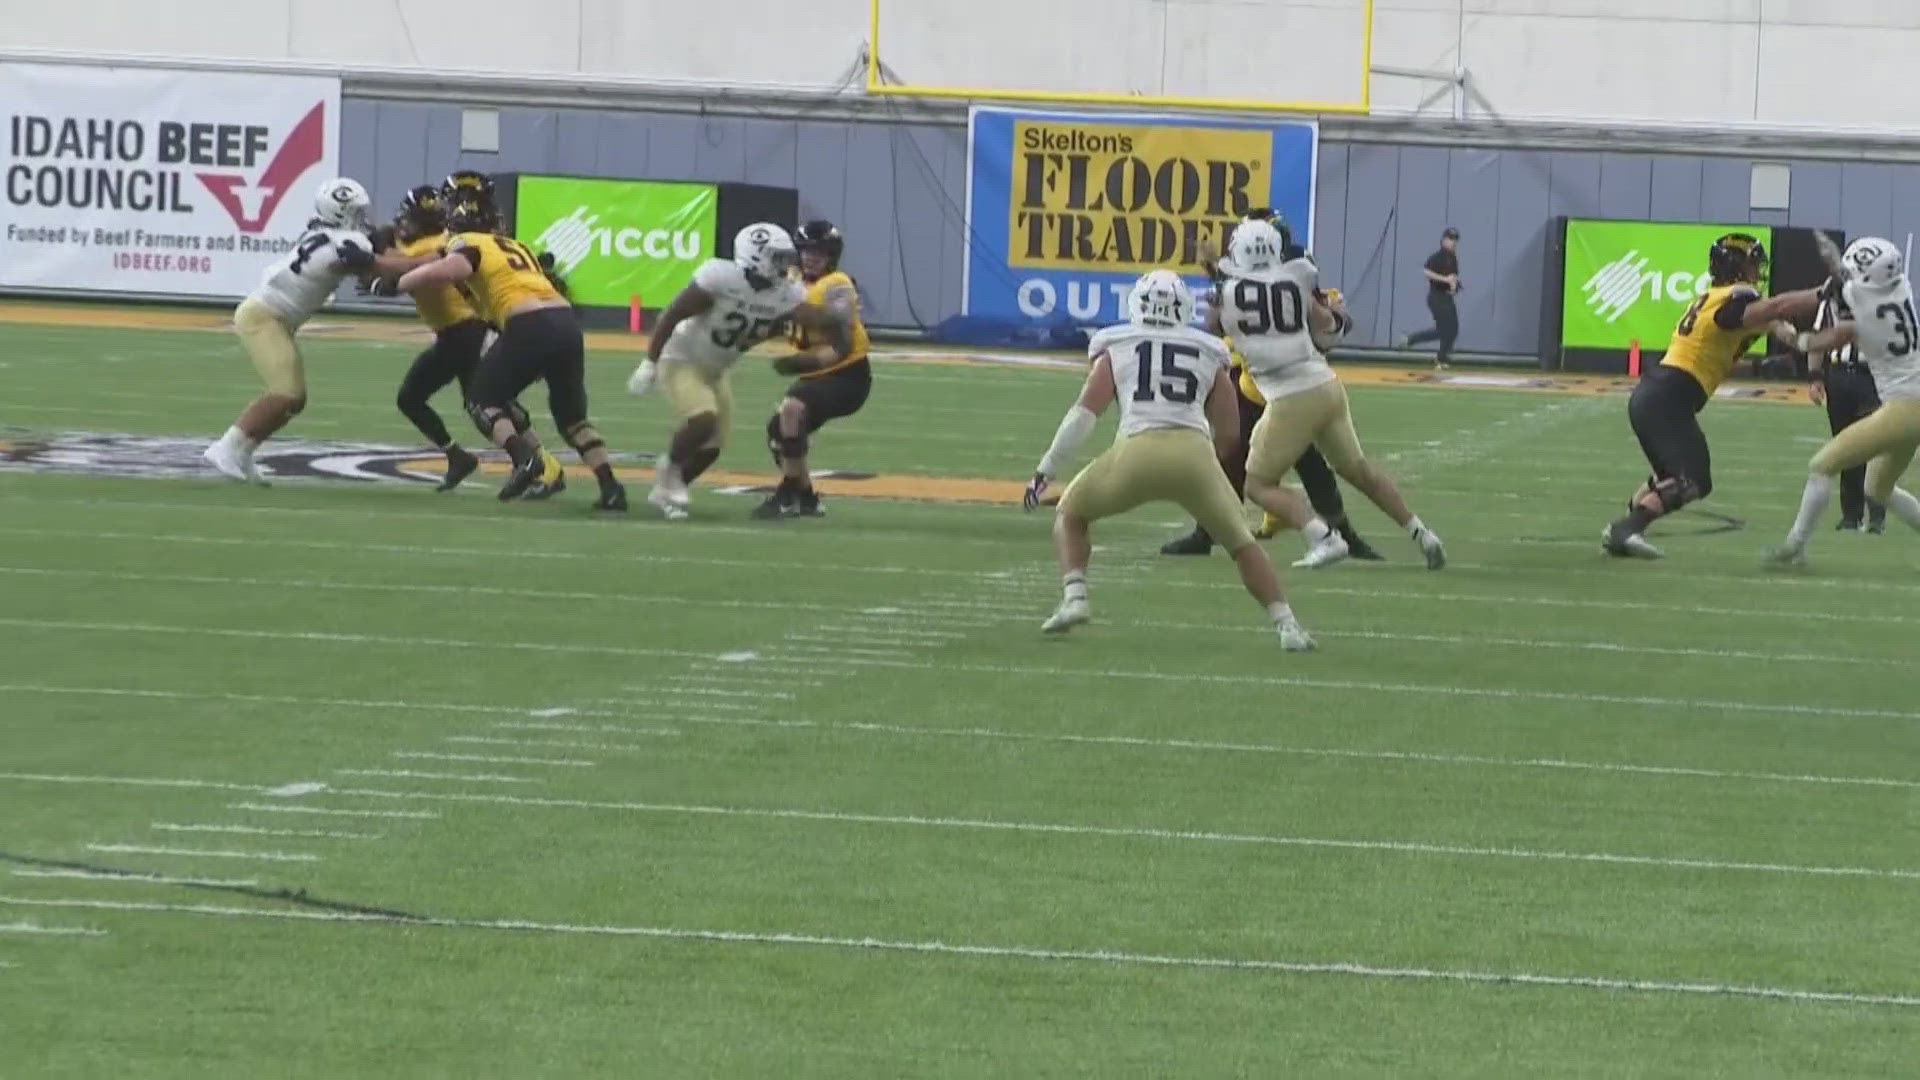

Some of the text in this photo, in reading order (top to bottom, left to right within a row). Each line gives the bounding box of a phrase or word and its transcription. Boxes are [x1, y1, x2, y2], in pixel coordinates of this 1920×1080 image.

[11, 115, 269, 167] IDAHO BEEF
[1023, 127, 1134, 154] Skelton's
[7, 164, 194, 213] COUNCIL
[7, 223, 66, 243] Funded
[71, 227, 89, 247] by
[94, 228, 130, 247] Beef
[135, 229, 200, 250] Farmers
[206, 233, 235, 251] and
[596, 226, 700, 259] ICCU
[113, 252, 212, 274] IDBEEF.ORG
[1234, 279, 1303, 336] 90
[1132, 339, 1200, 405] 15
